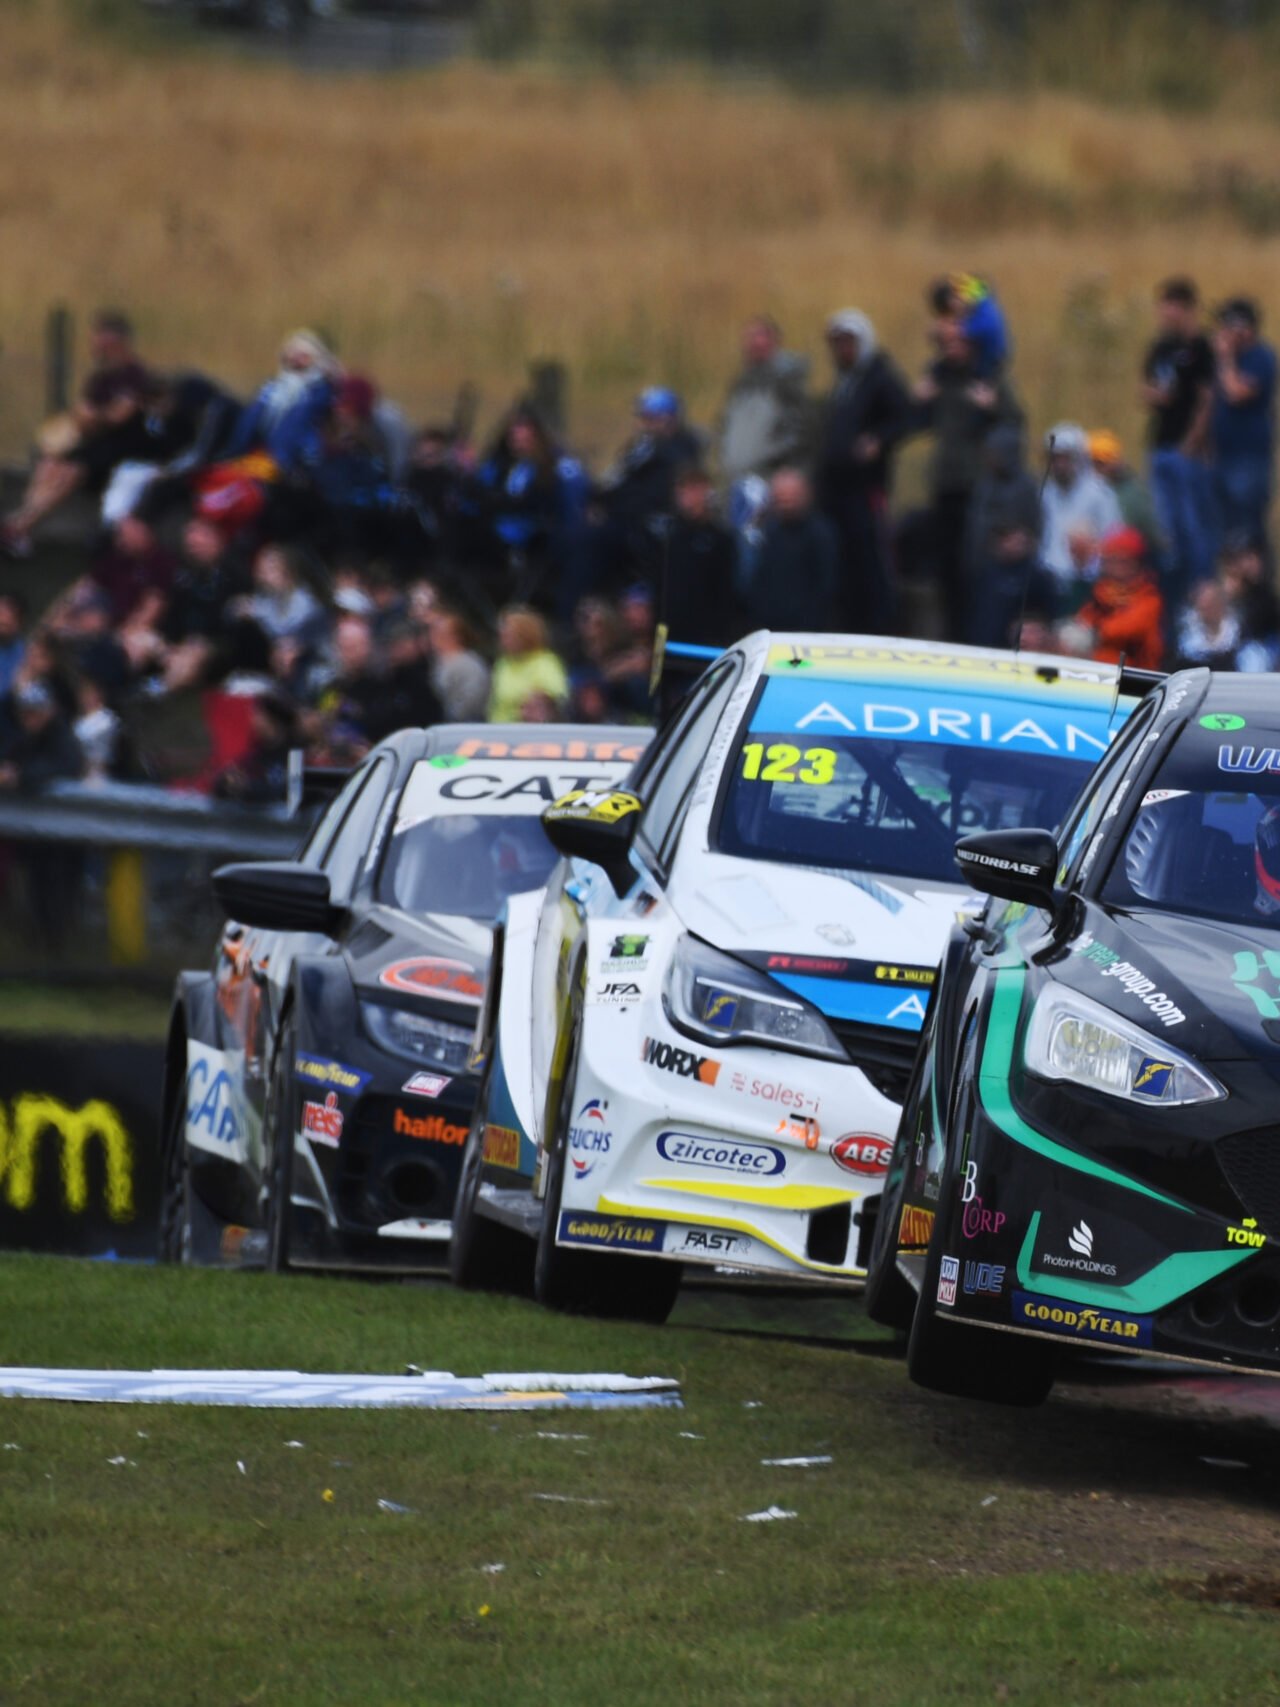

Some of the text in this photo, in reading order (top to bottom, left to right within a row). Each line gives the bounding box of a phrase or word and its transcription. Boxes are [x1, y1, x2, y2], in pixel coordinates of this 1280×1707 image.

[742, 742, 838, 785] 123
[440, 774, 625, 802] CAT
[956, 848, 1041, 876] MOTORBASE
[597, 982, 641, 995] JFA
[642, 1036, 706, 1081] WORX
[568, 1127, 612, 1153] FUCHS
[671, 1140, 768, 1169] zircotec
[842, 1142, 893, 1167] ABS
[684, 1230, 739, 1252] FAST
[1226, 1226, 1267, 1248] TOW
[1023, 1302, 1140, 1338] GOODYEAR
